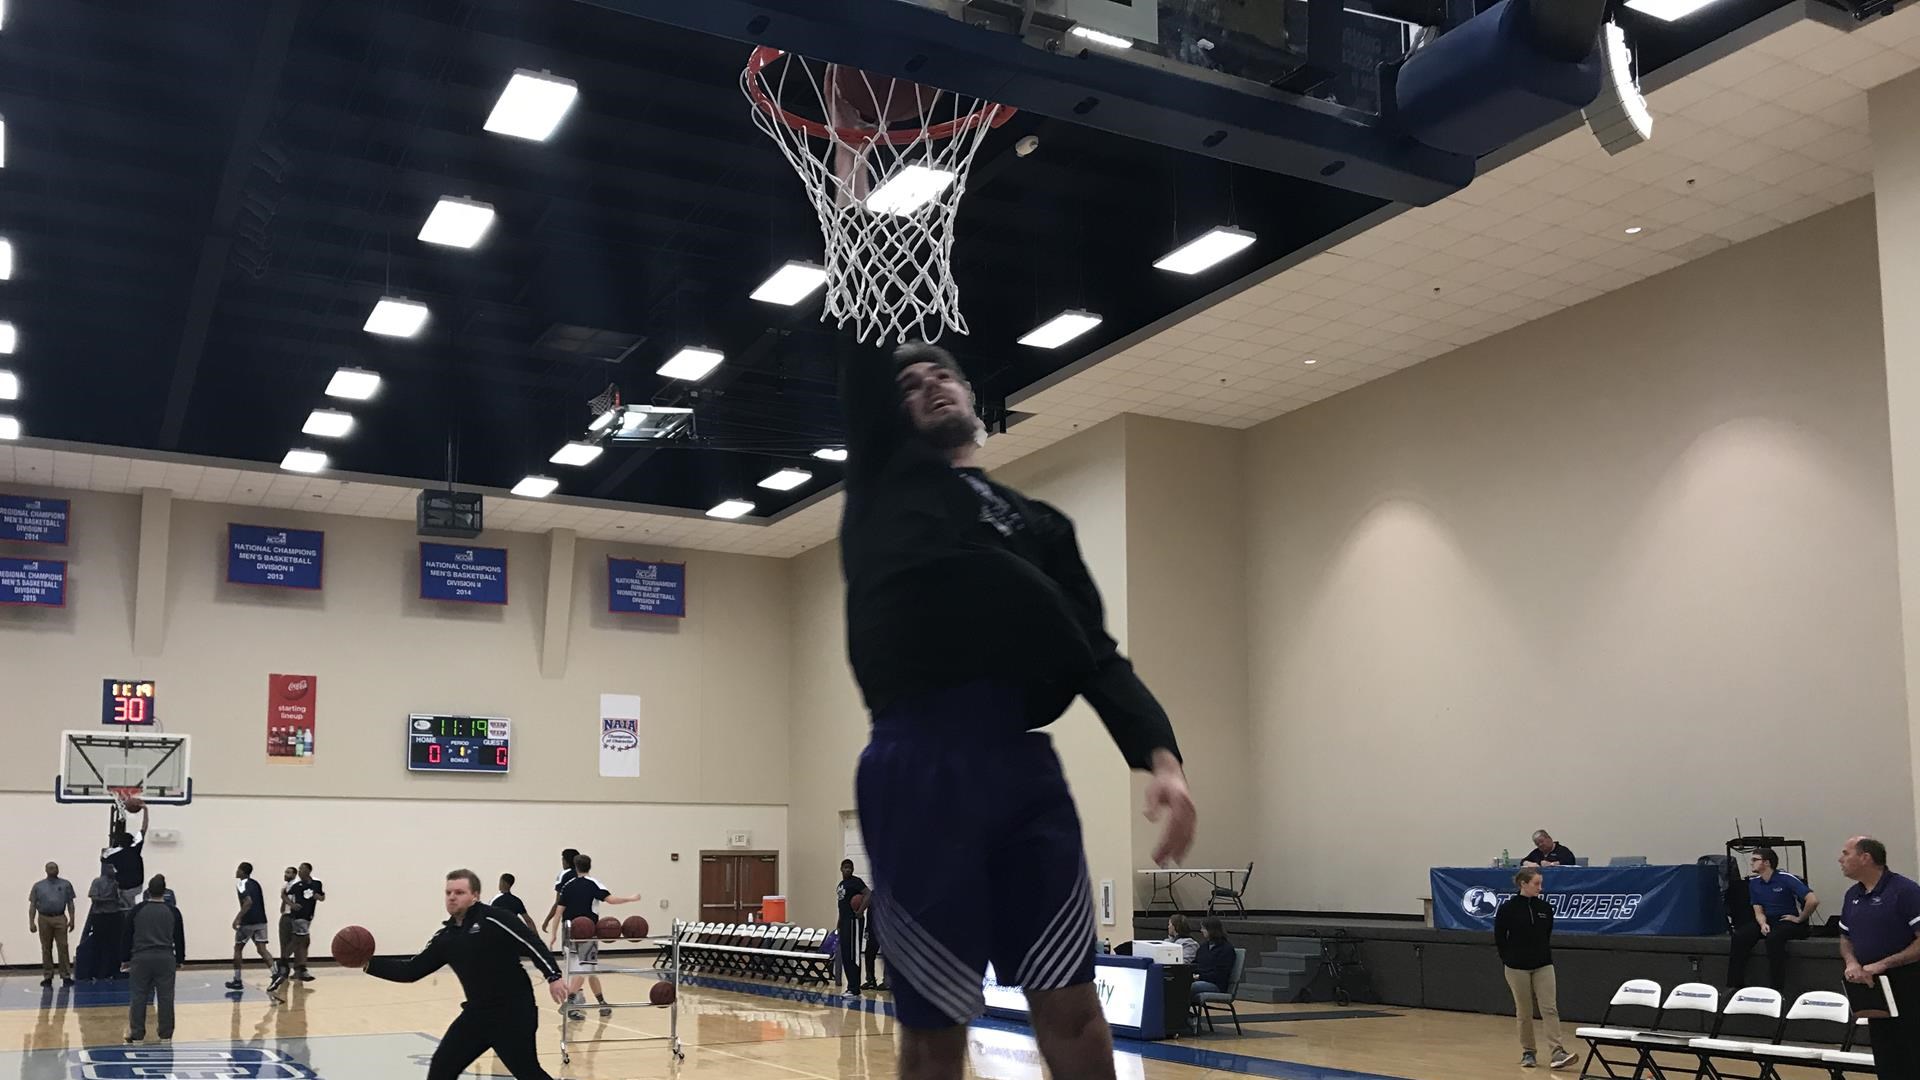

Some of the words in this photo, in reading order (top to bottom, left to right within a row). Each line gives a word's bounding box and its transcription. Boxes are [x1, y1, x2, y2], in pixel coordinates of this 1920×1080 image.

[24, 517, 60, 527] BASKETBALL
[16, 524, 42, 533] DIVISION
[234, 543, 272, 553] NATIONAL
[273, 546, 317, 557] CHAMPIONS
[239, 552, 263, 561] MEN'S
[263, 554, 312, 565] BASKETBALL
[256, 562, 288, 572] DIVISION
[425, 561, 460, 570] NATIONAL
[461, 563, 502, 573] CHAMPIONS
[28, 572, 62, 581] CHAMPIONS
[267, 572, 284, 580] 2013
[430, 569, 452, 578] MEN'S
[452, 571, 497, 581] BASKETBALL
[22, 579, 58, 588] BASKETBALL
[446, 579, 476, 588] DIVISION
[14, 586, 40, 594] DIVISION
[456, 588, 472, 596] 2014
[114, 697, 144, 721] 30
[278, 705, 307, 713] starting
[280, 712, 304, 720] lineup
[441, 719, 487, 737] 11:19
[604, 719, 636, 732] NAIA
[415, 736, 437, 744] HOME
[483, 738, 505, 746] GUEST
[429, 745, 440, 763] 0
